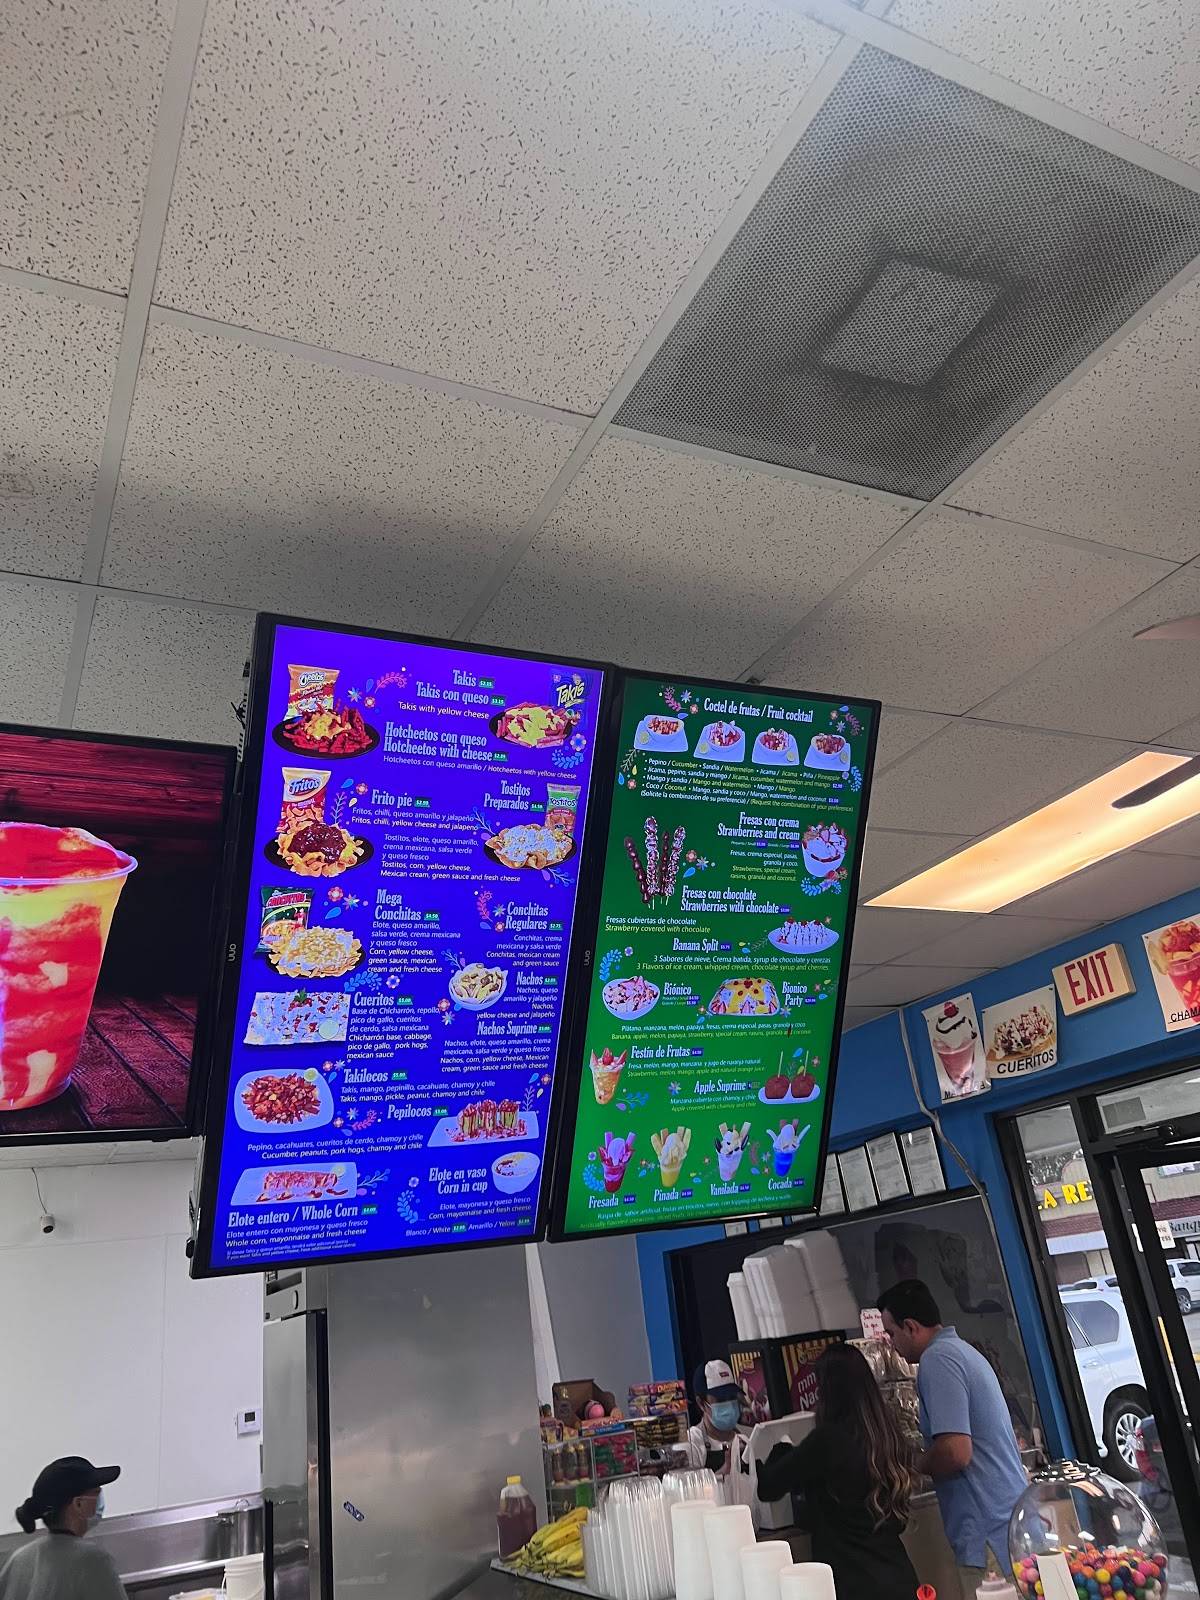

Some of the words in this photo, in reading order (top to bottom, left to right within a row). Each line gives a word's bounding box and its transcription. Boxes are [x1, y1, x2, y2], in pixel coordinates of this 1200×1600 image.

[452, 669, 479, 686] Takis
[416, 681, 440, 698] Takis
[442, 690, 459, 700] con
[462, 692, 491, 704] queso
[556, 682, 584, 706] Takis
[704, 697, 727, 712] Coctel
[728, 700, 737, 713] de
[738, 702, 760, 716] frutas
[766, 705, 784, 718] Fruit
[785, 708, 812, 722] cocktail
[384, 721, 438, 741] Hotcheetos
[440, 732, 457, 742] con
[460, 735, 486, 746] queso
[383, 736, 436, 755] Hotcheetos
[439, 744, 458, 757] with
[461, 742, 493, 760] cheese
[290, 778, 320, 794] Fritos
[501, 780, 530, 796] Tostitos
[371, 789, 394, 804] Frito
[397, 792, 414, 808] pie
[484, 793, 531, 810] Preparados
[738, 811, 762, 828] Fresas
[764, 817, 777, 829] con
[778, 819, 798, 827] crema
[717, 822, 763, 837] Strawberries
[764, 826, 777, 838] and
[778, 831, 799, 840] cream
[376, 889, 401, 907] Mega
[681, 885, 706, 900] Fresas
[707, 890, 720, 898] con
[722, 887, 756, 902] chocolate
[374, 905, 420, 920] Conchitas
[506, 901, 548, 917] Conchitas
[680, 898, 727, 911] Strawberries
[729, 898, 744, 912] with
[746, 899, 779, 913] chocolate
[505, 915, 549, 931] Regulares
[672, 938, 700, 950] Banana
[701, 938, 719, 952] Split
[516, 971, 545, 984] Nachos
[1064, 951, 1114, 1006] EXIT
[354, 992, 393, 1005] Cueritos
[477, 1021, 504, 1034] Nachos
[506, 1020, 540, 1036] Suprime
[655, 1045, 664, 1057] de
[666, 1044, 693, 1056] Frutas
[996, 1049, 1054, 1074] CUERITOS
[343, 1068, 388, 1082] Takilocos
[694, 1080, 715, 1094] Apple
[716, 1079, 748, 1092] Suprime
[387, 1103, 434, 1120] Pepilocos
[428, 1167, 451, 1183] Elote
[453, 1170, 464, 1179] en
[467, 1168, 486, 1177] vaso
[768, 1176, 794, 1189] Cocada
[438, 1180, 458, 1194] Corn
[461, 1179, 469, 1192] in
[472, 1181, 487, 1192] cup
[710, 1182, 741, 1195] Vanilada
[588, 1193, 618, 1208] Fresada
[228, 1212, 254, 1226] Elote
[257, 1211, 289, 1224] entero
[302, 1204, 332, 1220] Whole
[335, 1203, 357, 1216] Corn
